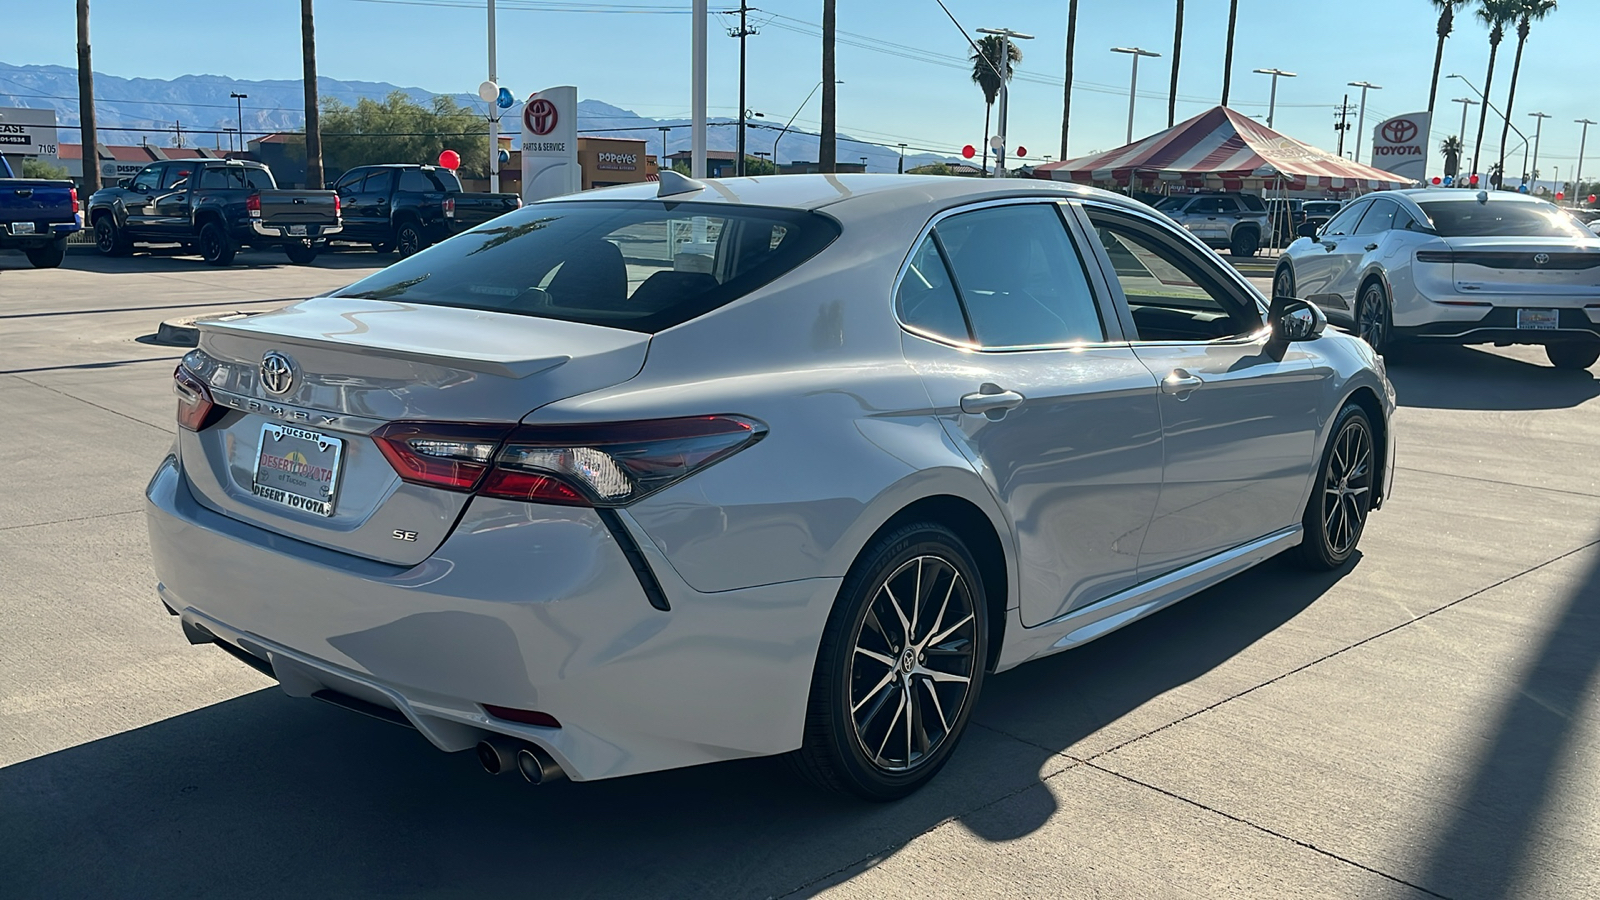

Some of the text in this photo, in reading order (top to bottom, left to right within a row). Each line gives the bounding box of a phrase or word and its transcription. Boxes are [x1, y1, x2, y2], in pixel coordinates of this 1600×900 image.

[38, 144, 56, 154] 7105
[523, 142, 565, 152] PARTS & SERVICE
[1374, 145, 1422, 156] TOYOTA
[281, 426, 320, 442] TUCSON
[261, 452, 333, 482] DESERT TOYOTA
[286, 475, 307, 487] Tucson
[253, 485, 325, 515] DESERT TOYOTA
[392, 529, 419, 542] SE
